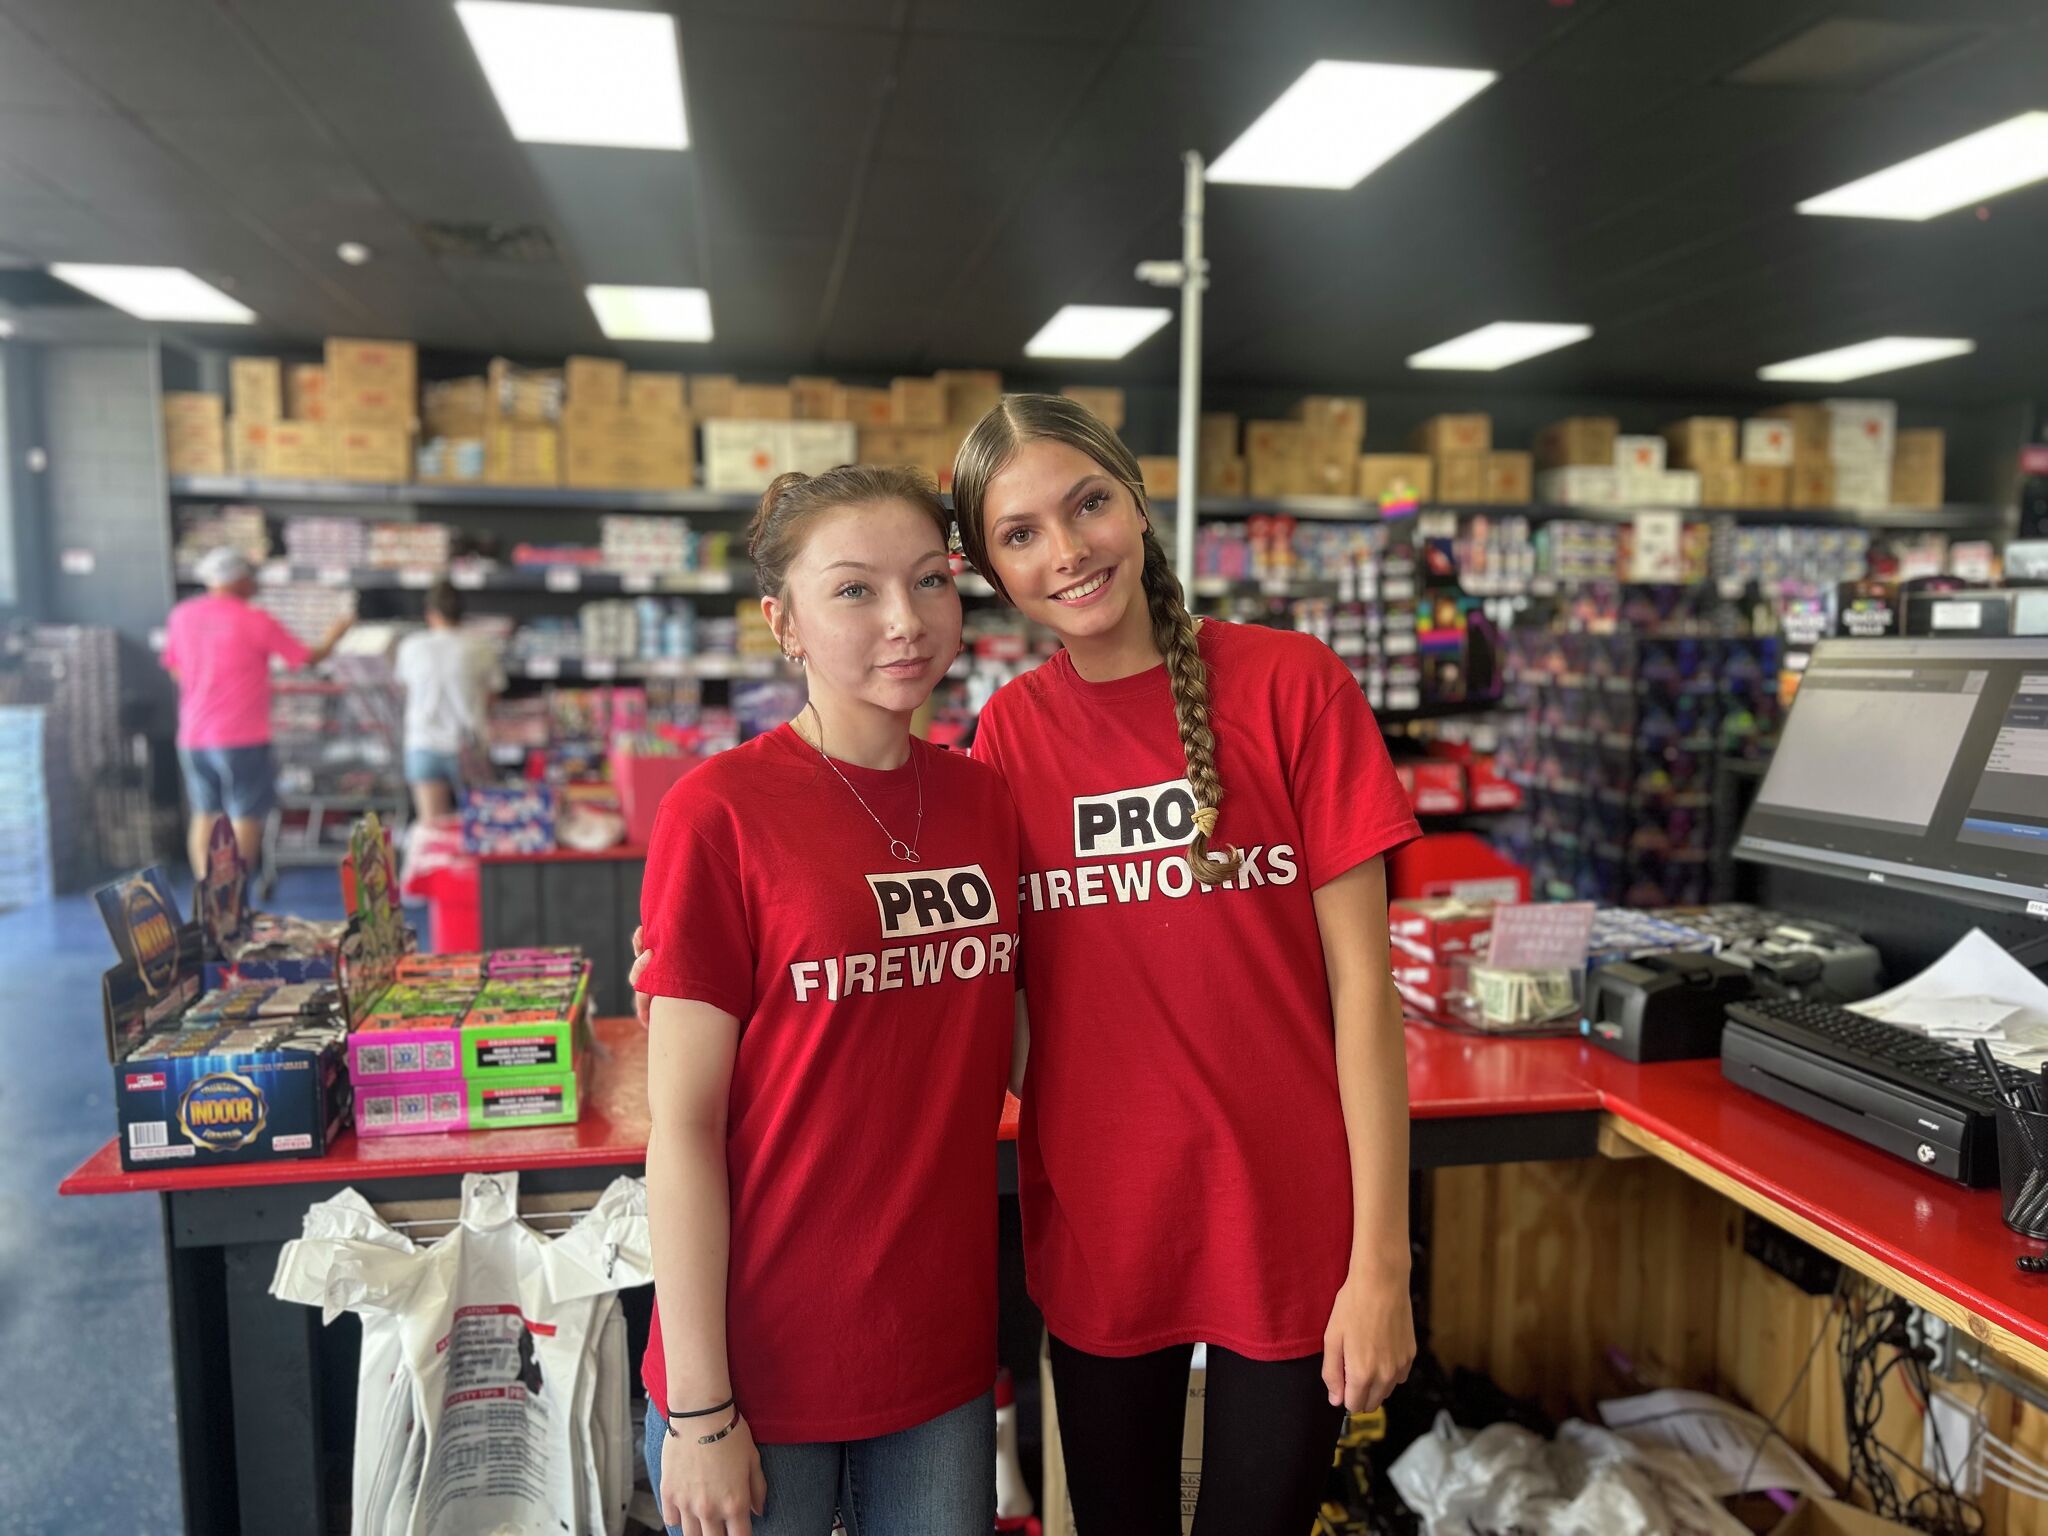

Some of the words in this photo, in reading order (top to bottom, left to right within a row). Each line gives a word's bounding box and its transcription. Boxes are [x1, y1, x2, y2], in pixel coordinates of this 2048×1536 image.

[1078, 787, 1195, 850] PRO
[873, 872, 992, 931] PRO
[189, 1097, 254, 1126] INDOOR
